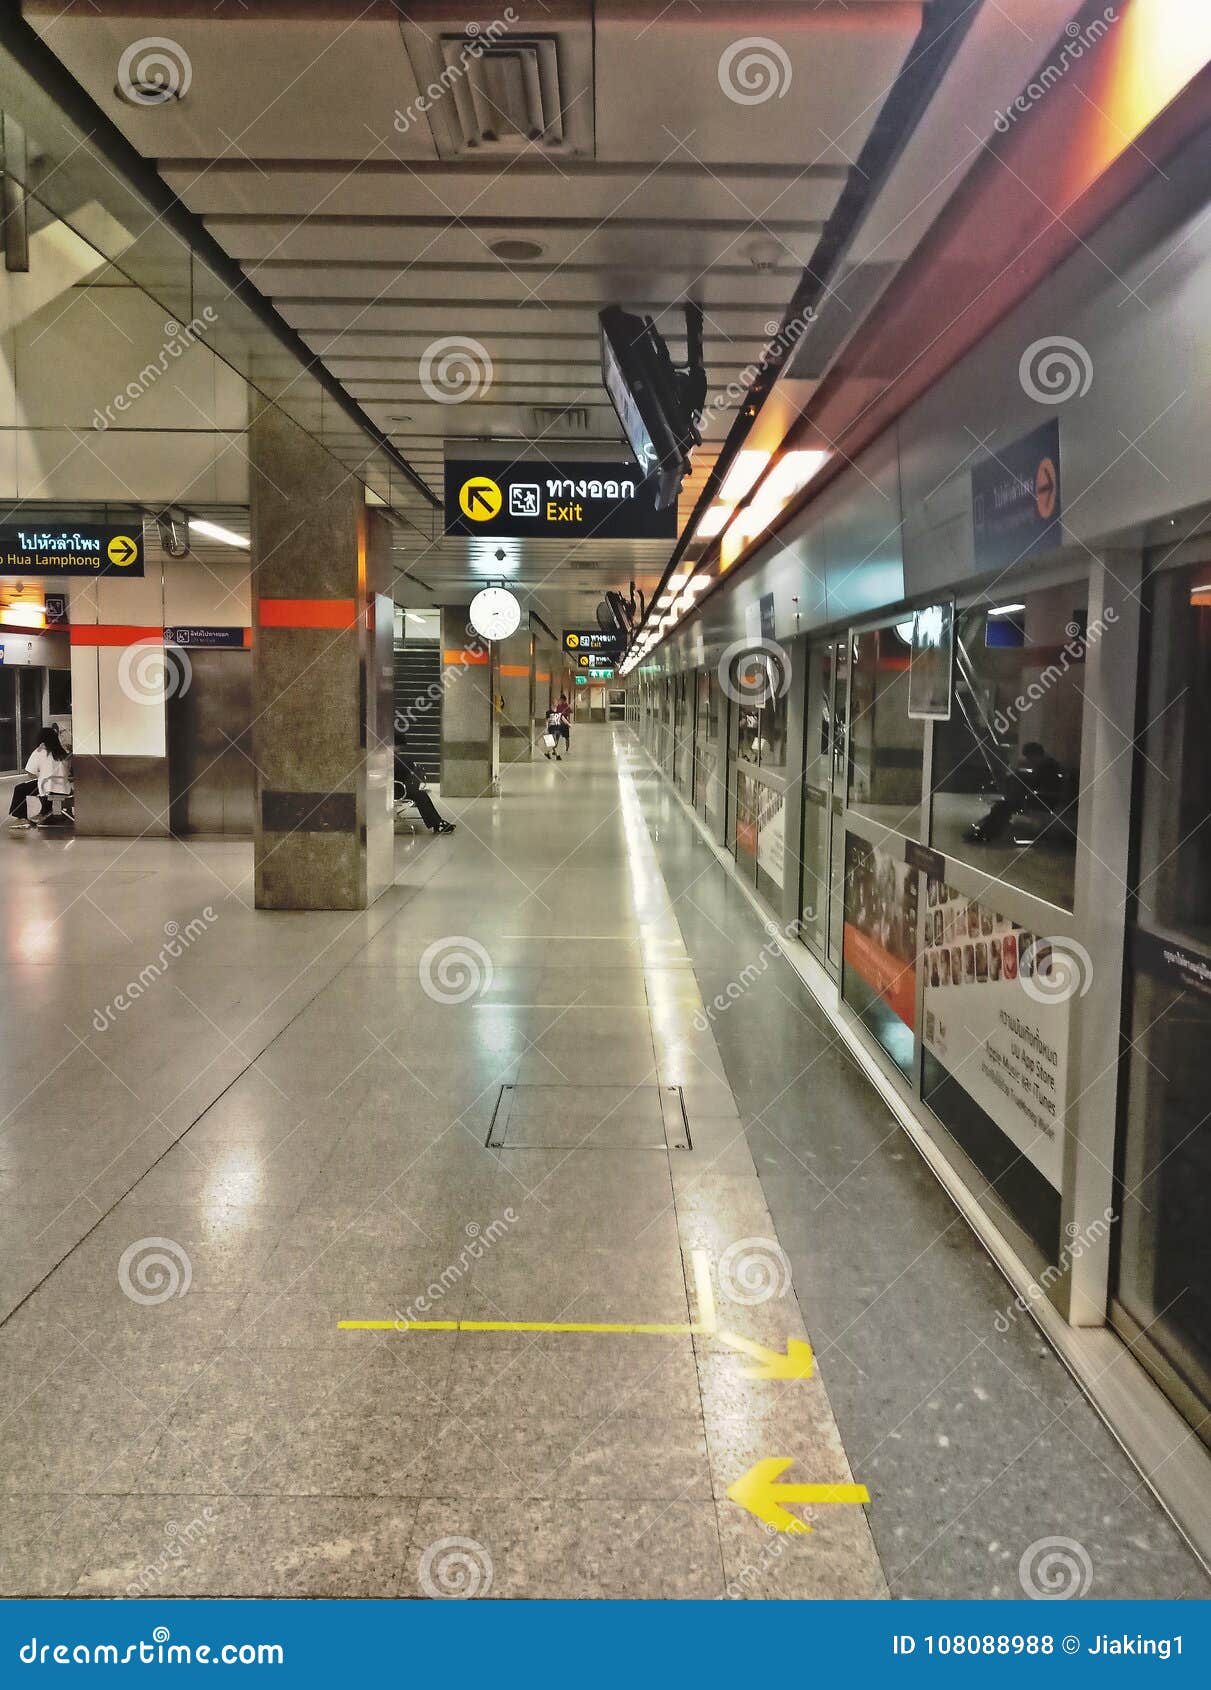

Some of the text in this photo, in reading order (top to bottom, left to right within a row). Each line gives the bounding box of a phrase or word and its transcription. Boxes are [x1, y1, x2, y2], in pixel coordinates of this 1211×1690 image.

[546, 480, 634, 498] ทางออก
[546, 502, 582, 521] Exit
[18, 532, 100, 550] ไปหัวลำโพง
[7, 554, 31, 565] Hua
[35, 554, 100, 567] Lamphong
[1036, 1059, 1055, 1090] Store
